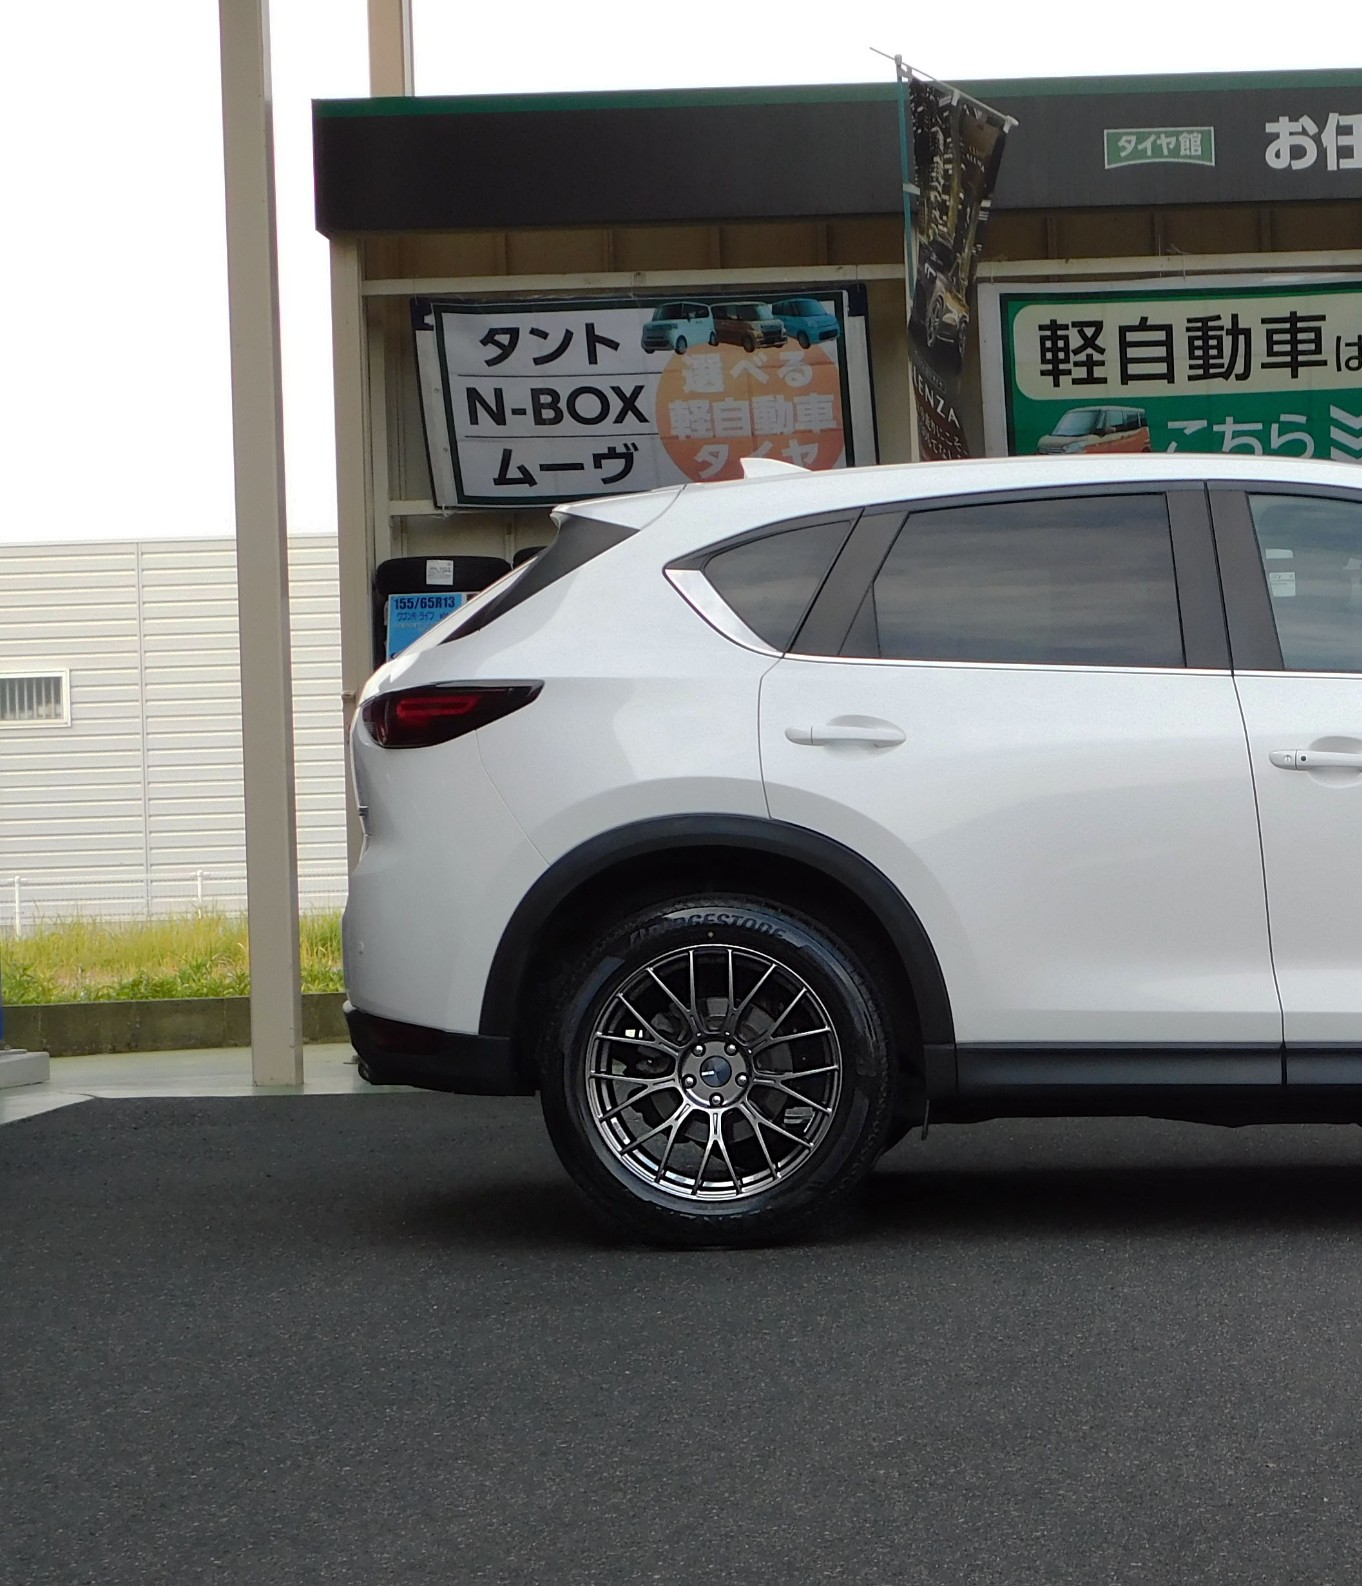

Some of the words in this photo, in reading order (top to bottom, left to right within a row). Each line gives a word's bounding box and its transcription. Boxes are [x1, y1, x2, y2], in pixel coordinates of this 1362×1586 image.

[1118, 132, 1201, 157] タイヤ館
[479, 322, 620, 367] タント
[682, 351, 813, 393] 選べる
[466, 385, 650, 426] N-BOX
[668, 393, 837, 440] 軽自動車
[492, 442, 639, 488] ムーヴ
[394, 596, 455, 610] 155/65R13
